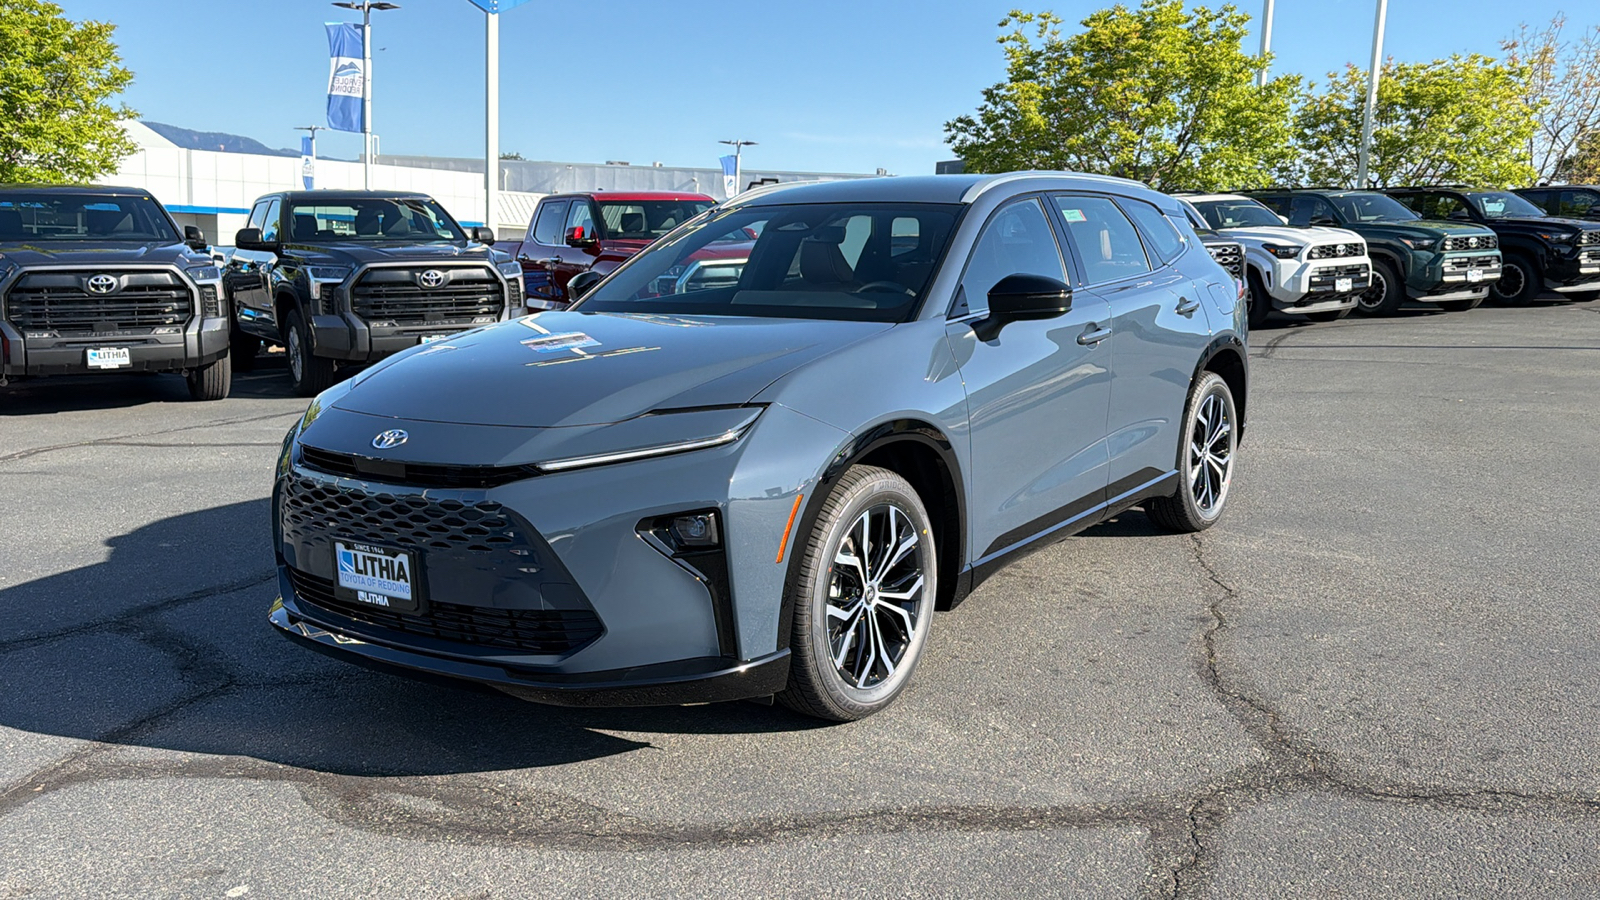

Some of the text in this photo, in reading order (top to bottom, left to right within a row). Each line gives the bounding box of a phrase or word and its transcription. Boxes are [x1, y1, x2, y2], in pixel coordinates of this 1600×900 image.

[97, 351, 127, 359] LITHIA
[354, 544, 370, 552] SINCE
[354, 553, 408, 583] LITHIA
[341, 573, 410, 594] TOYOTA OF REDDING
[365, 591, 389, 607] LITHIA
